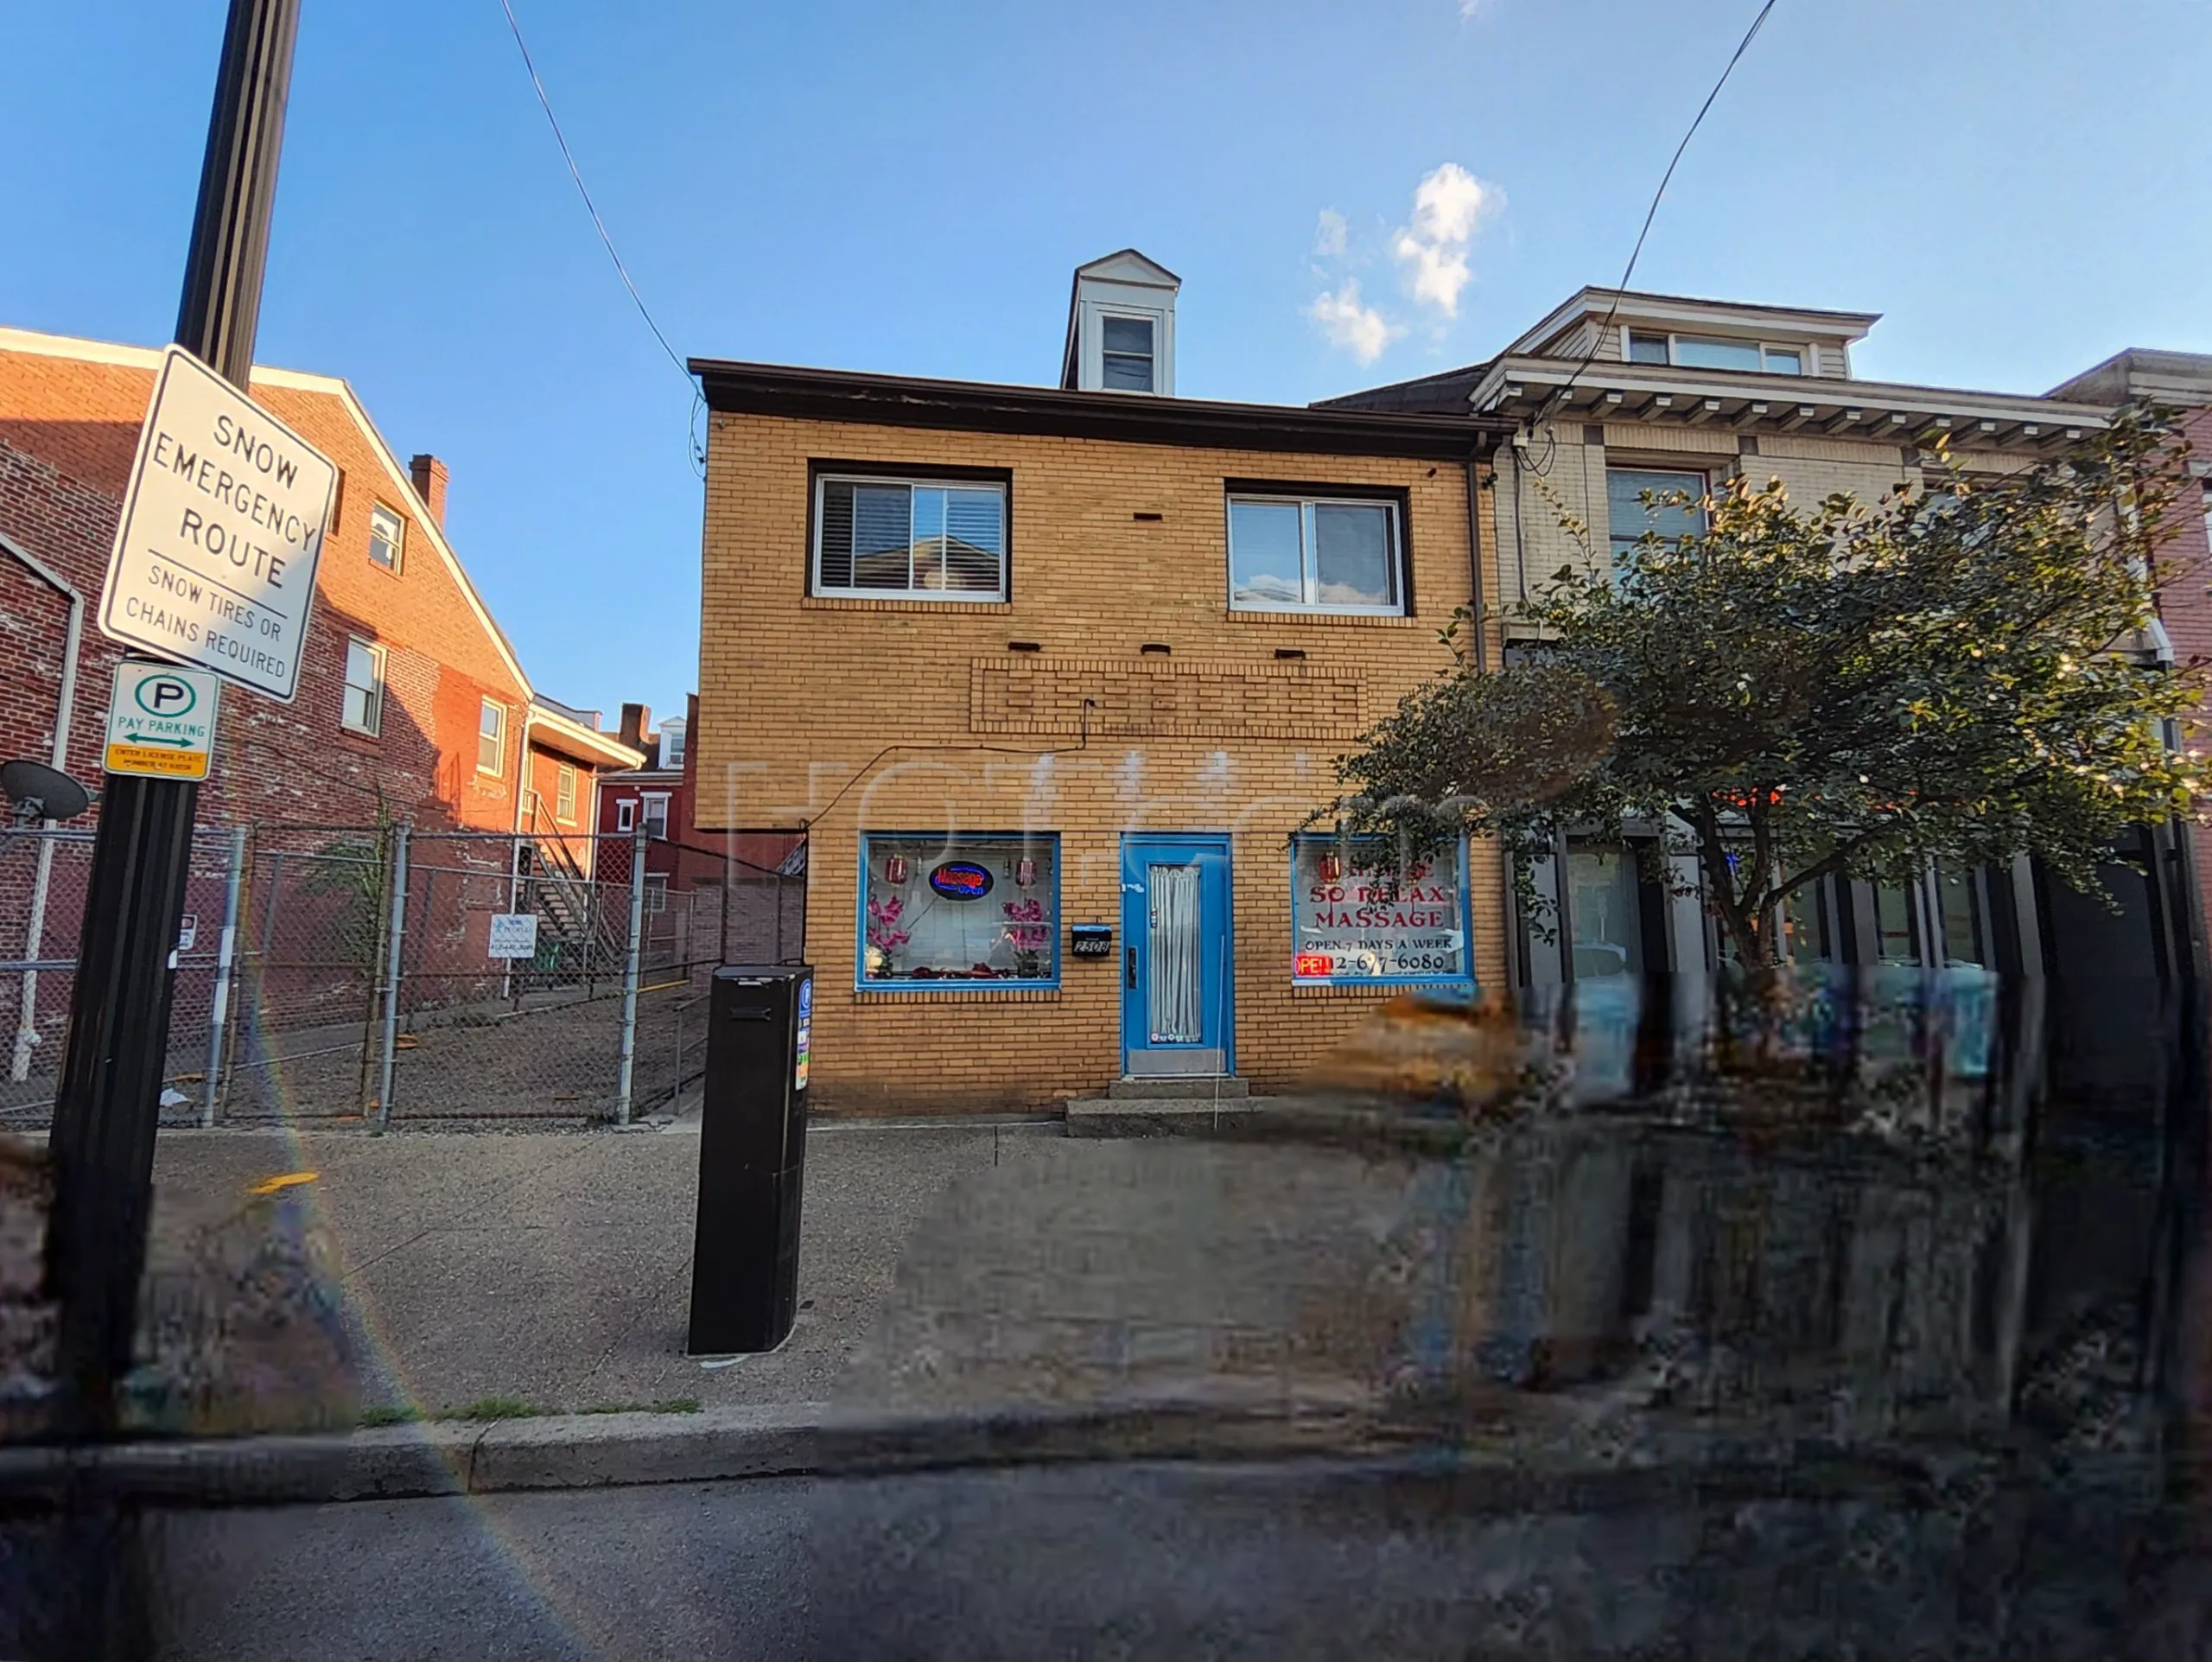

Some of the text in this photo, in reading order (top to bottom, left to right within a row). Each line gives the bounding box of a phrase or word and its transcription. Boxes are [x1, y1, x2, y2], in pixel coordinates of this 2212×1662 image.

[213, 415, 299, 490] SNOW
[153, 430, 317, 553] EMERGENCY
[179, 507, 287, 589] ROUTE
[148, 564, 282, 642] SNOW TIRES OR
[126, 596, 286, 679] CHAINS REQUIRED
[154, 682, 184, 709] P
[118, 716, 206, 737] PAY PARKING
[1309, 886, 1345, 903] SO
[1314, 910, 1445, 929] MASSAGE
[1305, 938, 1452, 952] OPEN 7 DAYS A WEEK
